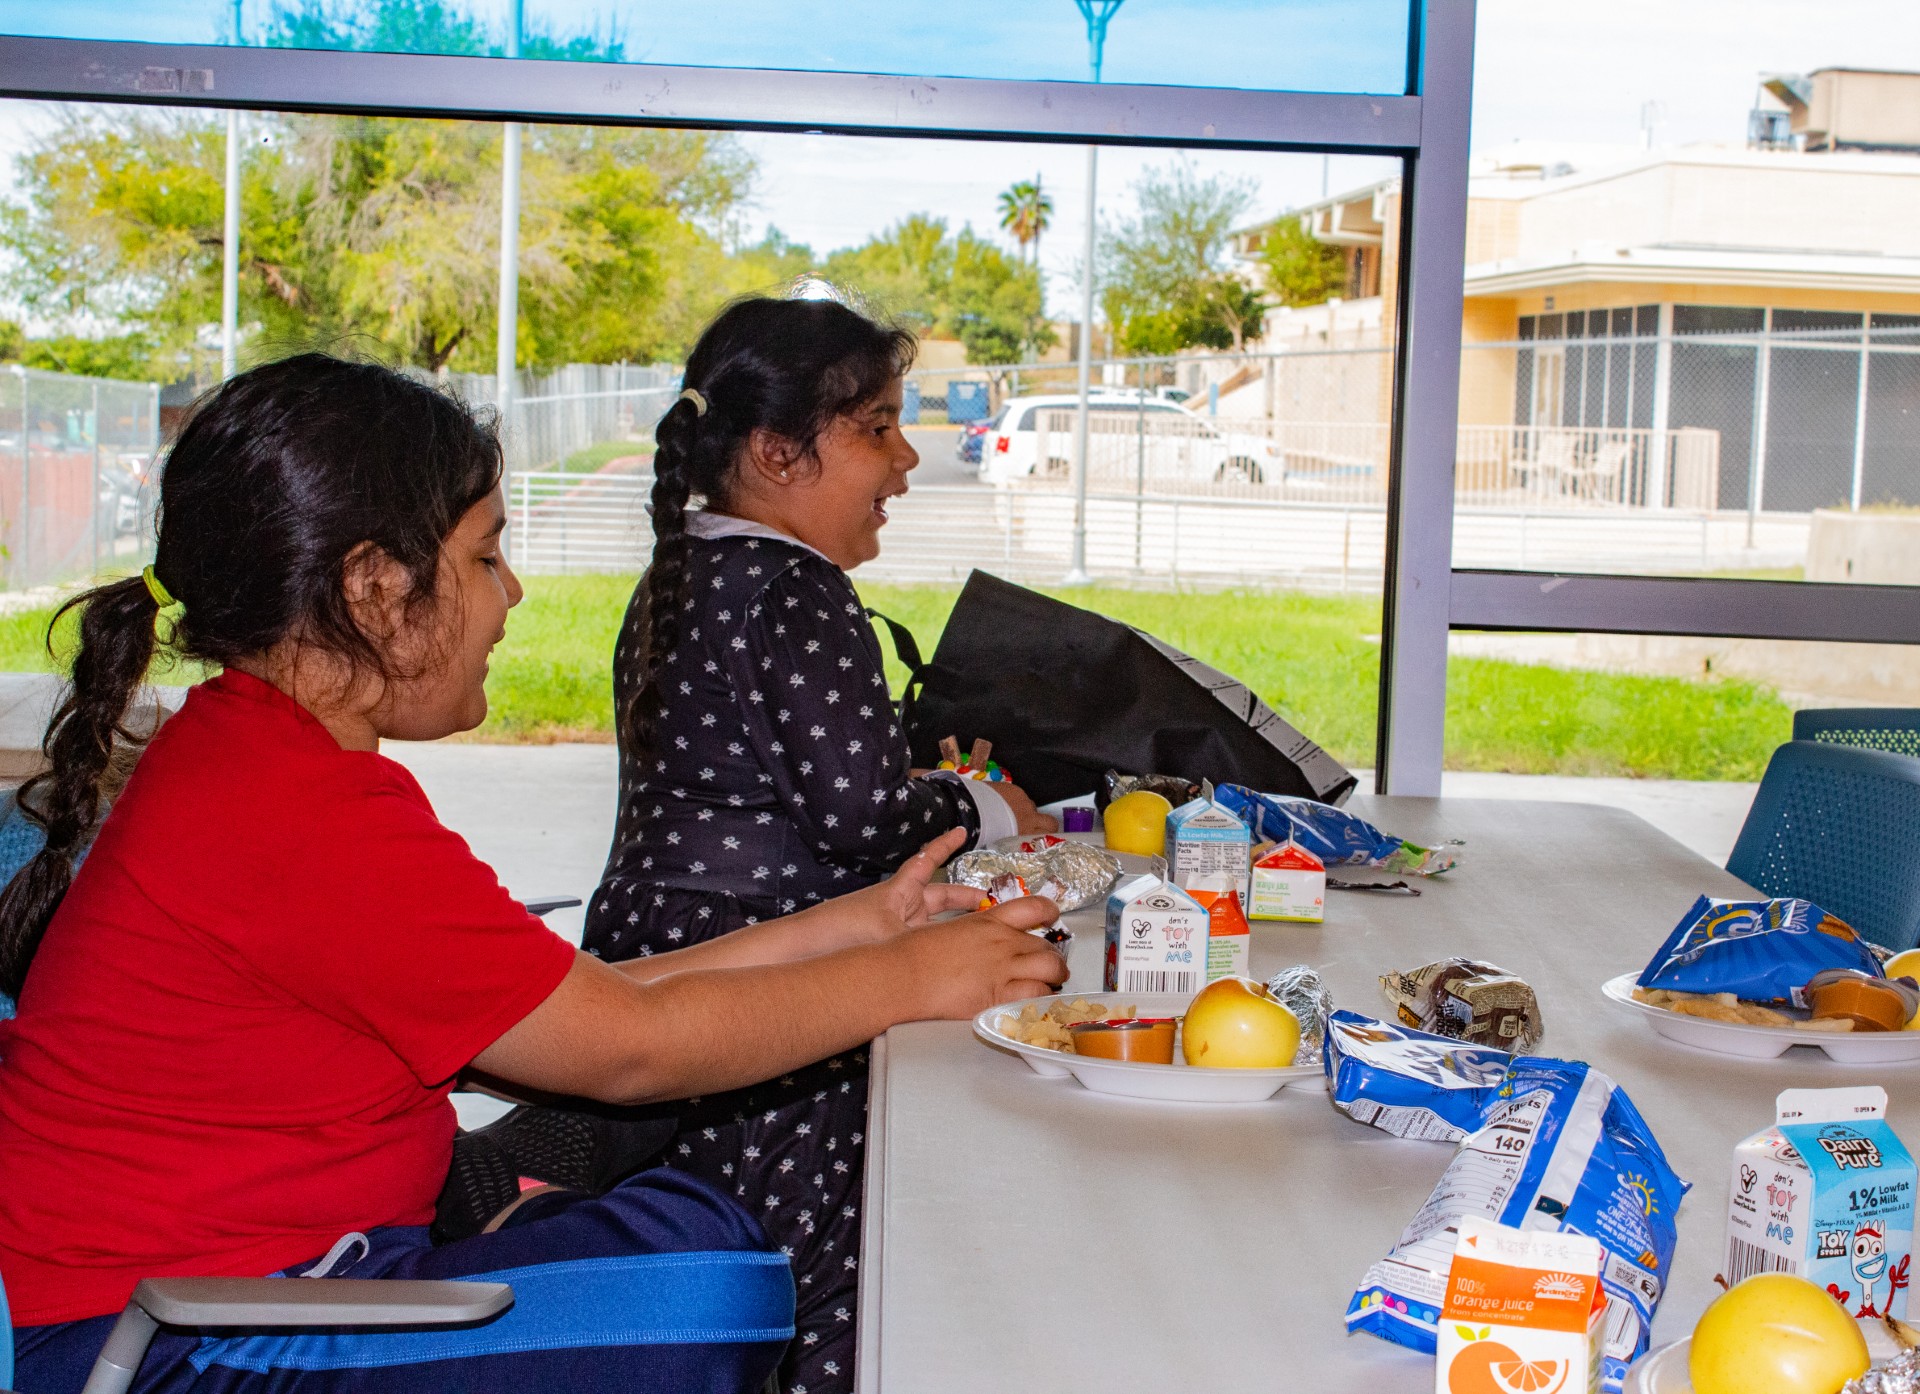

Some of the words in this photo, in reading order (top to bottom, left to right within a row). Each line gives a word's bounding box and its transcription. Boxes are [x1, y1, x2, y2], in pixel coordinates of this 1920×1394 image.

[1168, 916, 1188, 924] don't
[1162, 926, 1194, 941] TOY
[1169, 941, 1187, 950] with
[1495, 1135, 1525, 1151] 140
[1818, 1138, 1878, 1154] Dairy
[1833, 1152, 1882, 1170] Pure
[1774, 1171, 1794, 1186] don't
[1879, 1182, 1909, 1194] Lowfat
[1766, 1183, 1798, 1212] TOY
[1849, 1187, 1878, 1211] 1%
[1880, 1194, 1898, 1205] Milk
[1771, 1210, 1789, 1223] with
[1818, 1230, 1850, 1248] TOY
[1456, 1277, 1485, 1295] 100%
[1501, 1298, 1534, 1311] juice
[1449, 1308, 1470, 1316] from
[1472, 1310, 1525, 1321] concentrate
